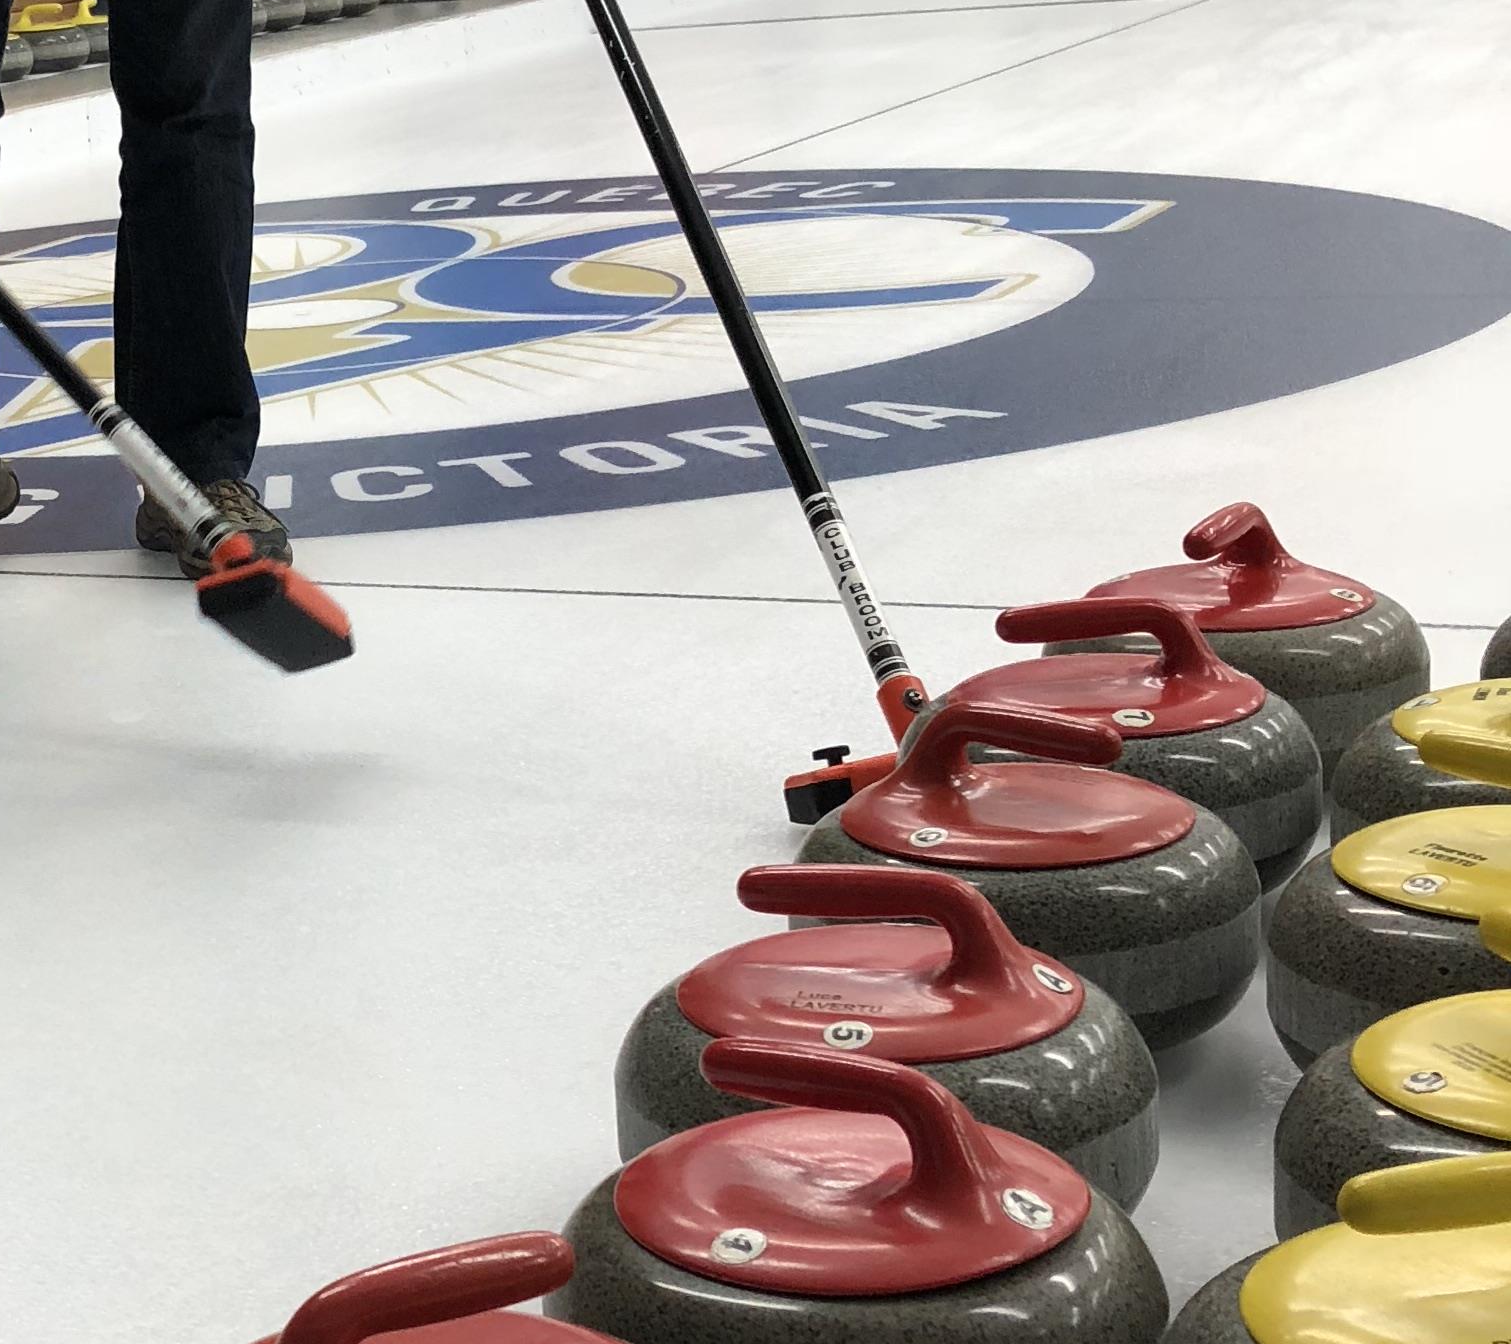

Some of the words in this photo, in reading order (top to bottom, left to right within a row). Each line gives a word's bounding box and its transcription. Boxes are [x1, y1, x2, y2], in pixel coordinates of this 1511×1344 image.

[264, 400, 1009, 510] ICTORIA
[790, 1000, 884, 1014] LAVERTU
[831, 1027, 865, 1041] 5
[1009, 1191, 1048, 1225] A
